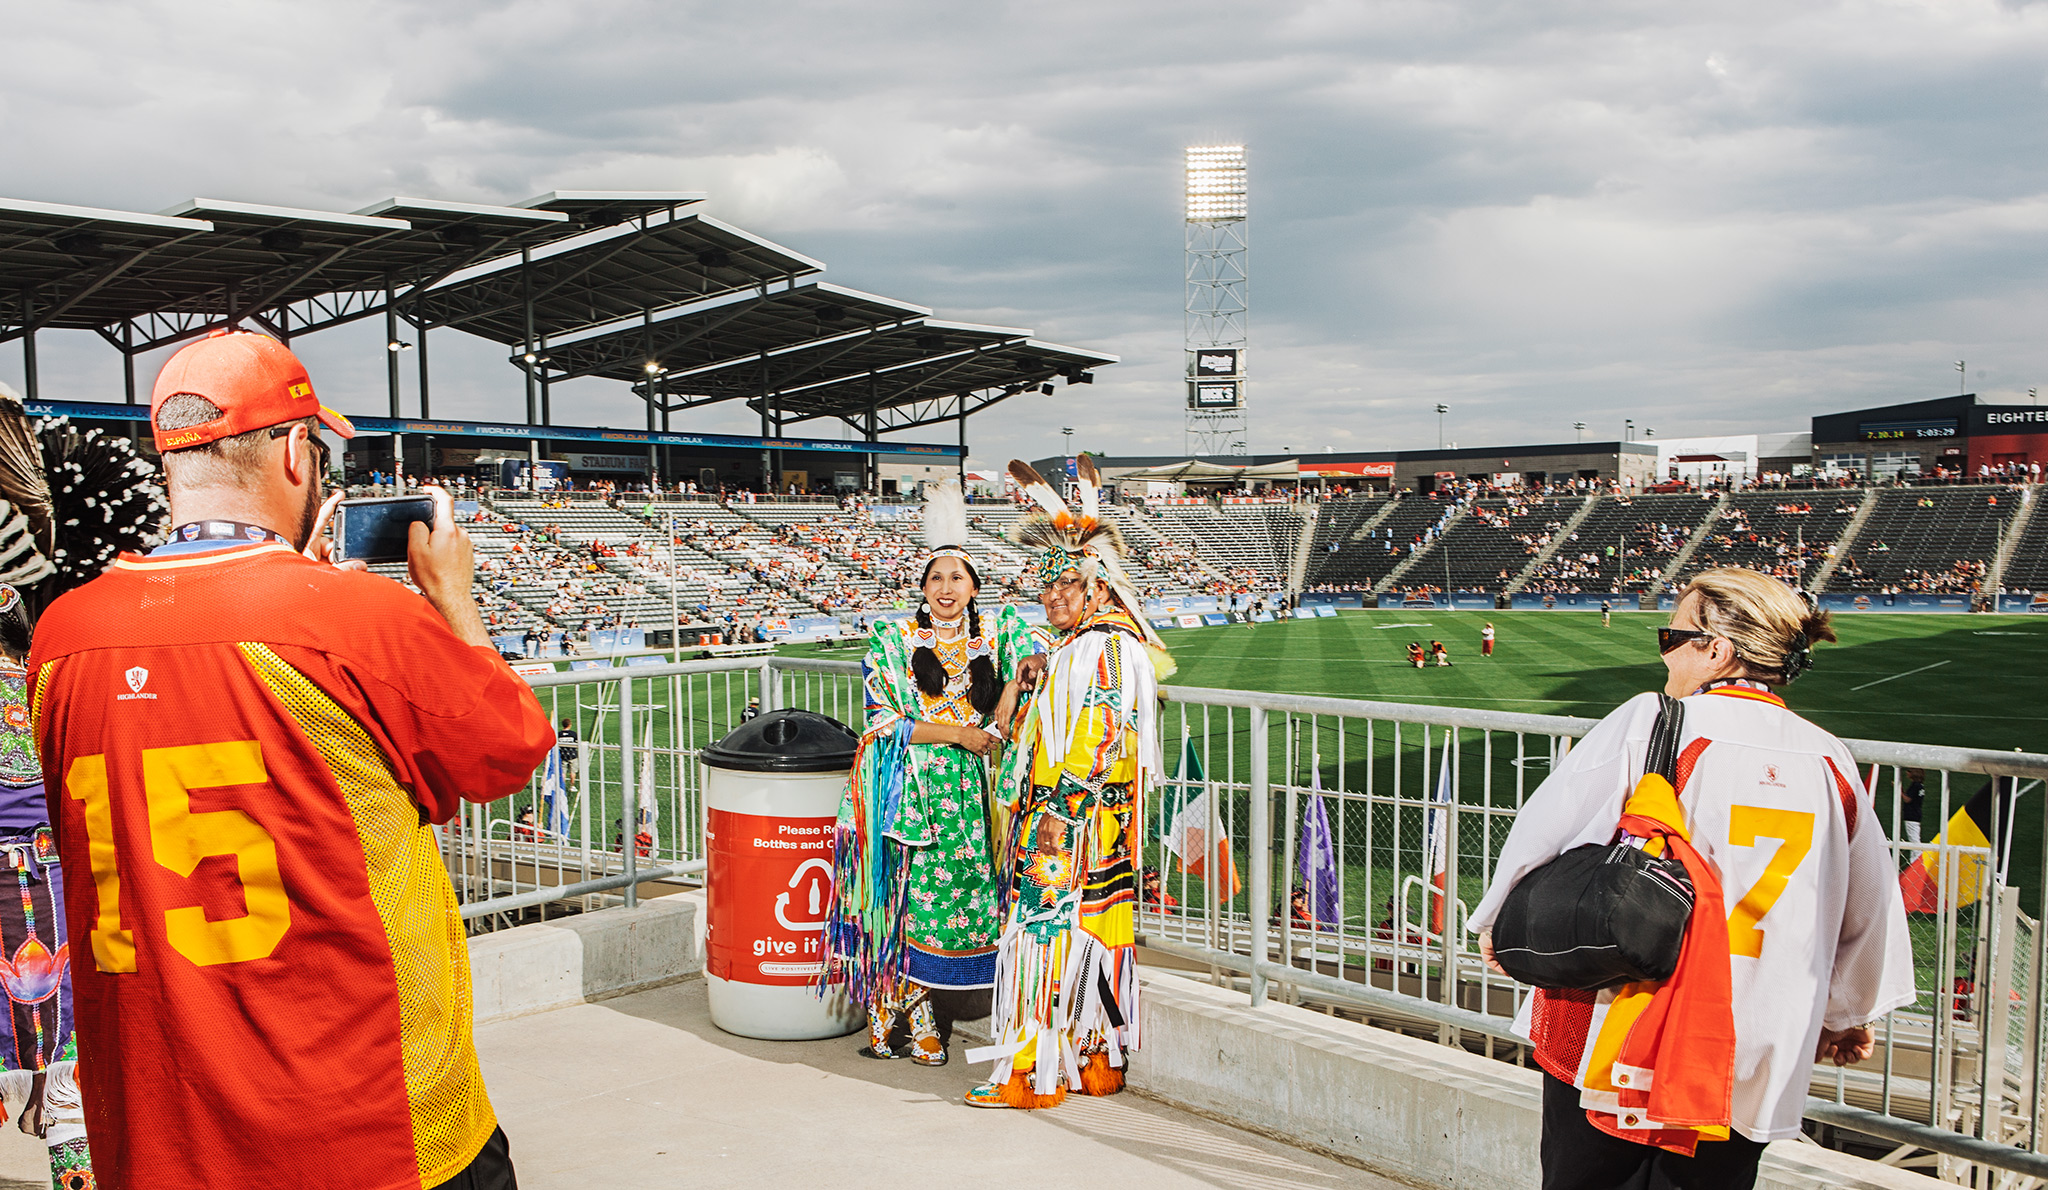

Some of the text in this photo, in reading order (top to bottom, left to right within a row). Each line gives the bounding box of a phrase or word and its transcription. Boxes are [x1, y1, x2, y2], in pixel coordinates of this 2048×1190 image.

[165, 432, 202, 447] ESPAÑA
[406, 423, 464, 433] #WORLDLAX
[475, 426, 530, 436] #WORLDLAX
[601, 433, 649, 441] #WORLDLAX
[657, 435, 703, 444] #WORLDLAX
[581, 456, 626, 468] STADIUM
[117, 693, 158, 701] HIGHLANDER
[778, 825, 820, 835] Please
[753, 838, 797, 849] Bottles
[800, 840, 824, 850] and
[66, 740, 291, 974] 15
[1727, 804, 1816, 959] 7
[752, 936, 797, 957] give
[804, 936, 819, 954] it
